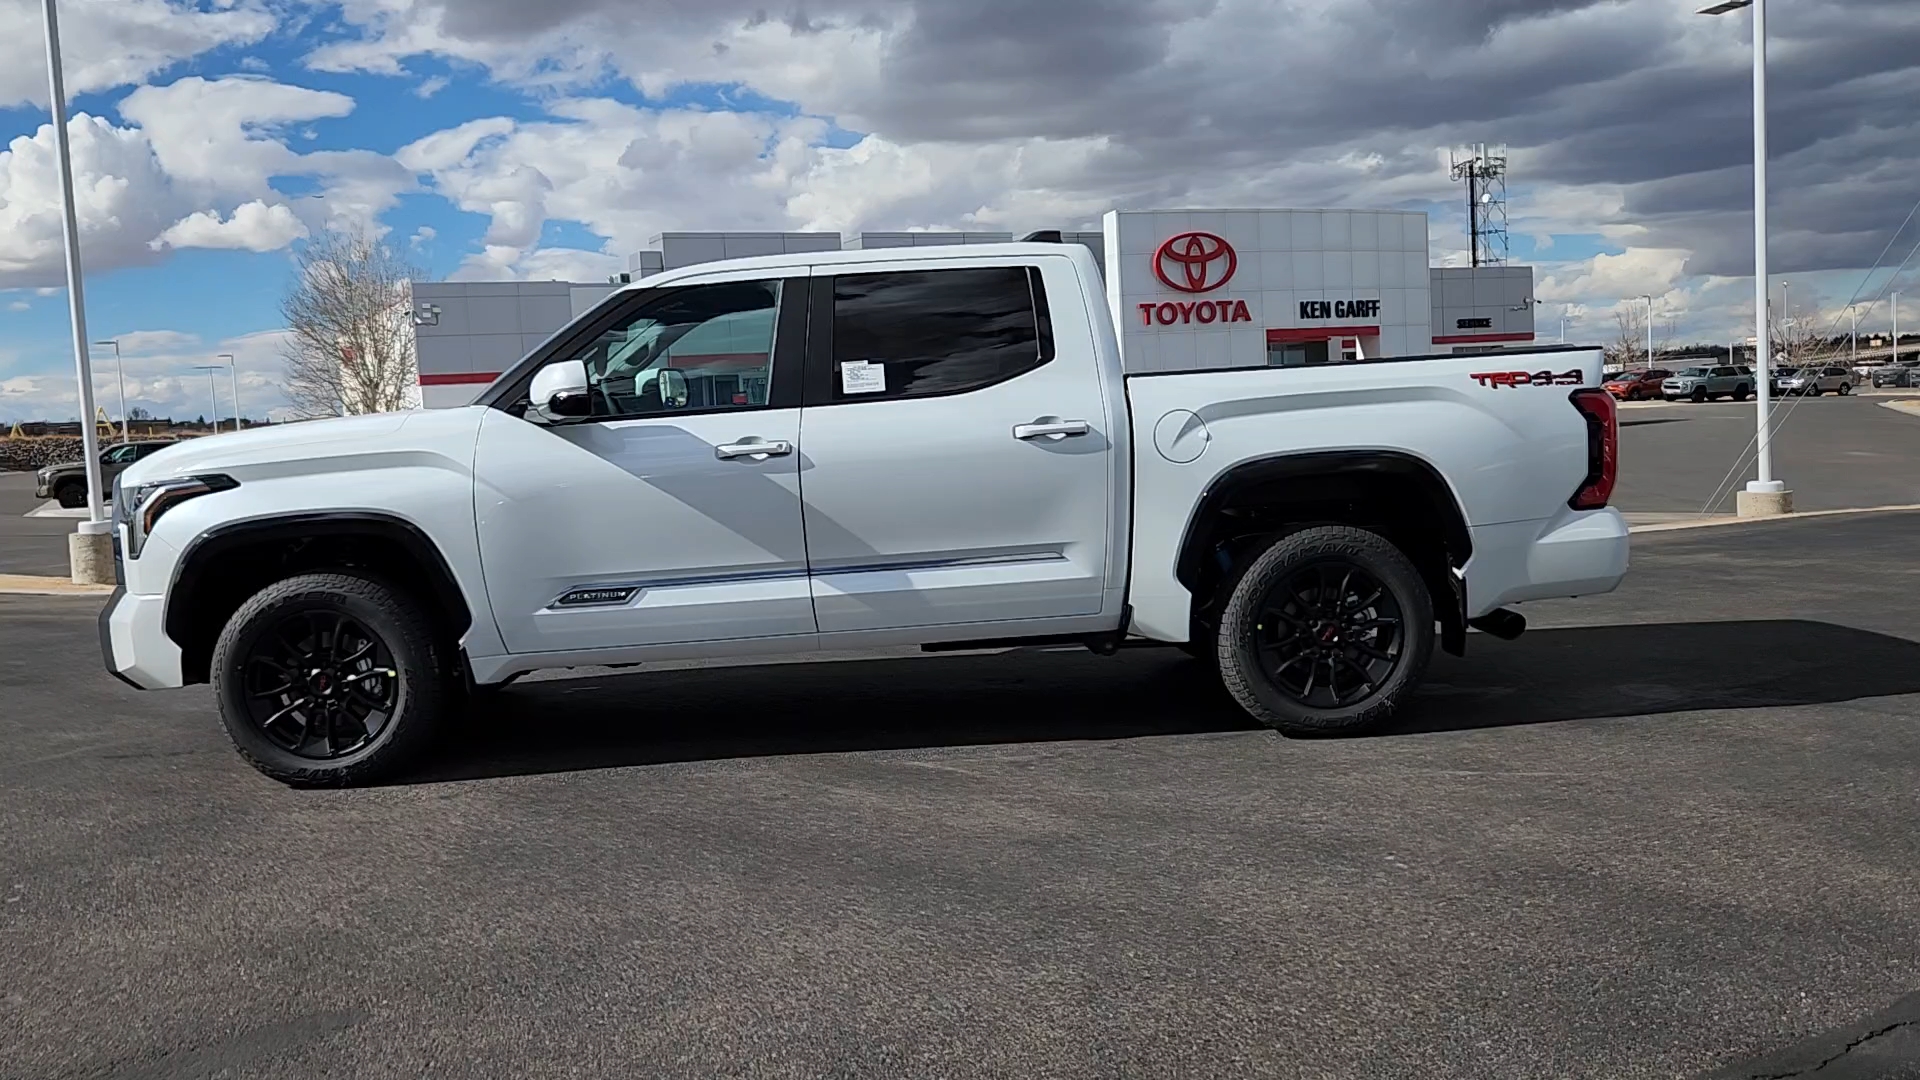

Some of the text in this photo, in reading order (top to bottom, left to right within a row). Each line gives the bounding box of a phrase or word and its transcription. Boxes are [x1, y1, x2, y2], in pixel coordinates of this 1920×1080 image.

[1137, 300, 1252, 326] TOYOTA
[1300, 300, 1380, 319] KEN GARFF
[1470, 371, 1531, 389] TRD
[569, 591, 627, 600] PLATINUM
